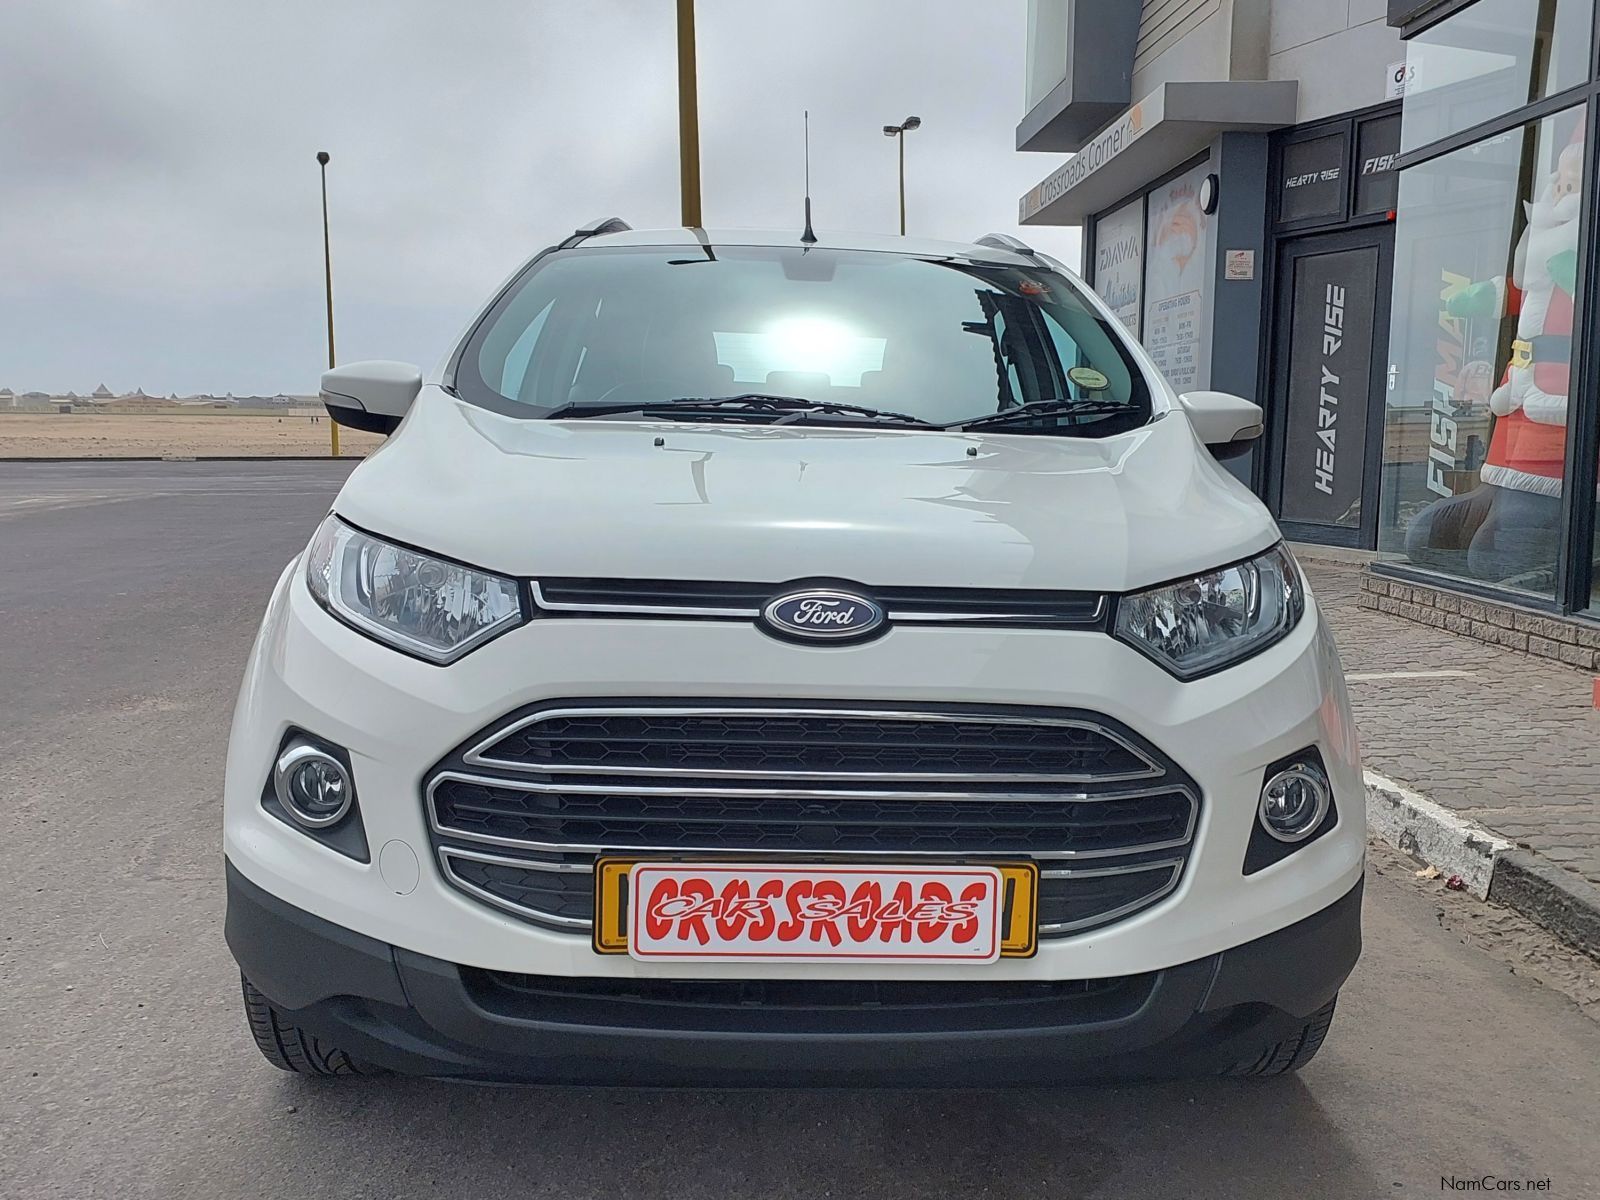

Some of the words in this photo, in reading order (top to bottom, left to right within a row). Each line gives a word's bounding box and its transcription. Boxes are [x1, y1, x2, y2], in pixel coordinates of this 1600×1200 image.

[1040, 155, 1086, 206] Crossroads
[1088, 122, 1126, 171] Corner
[1285, 172, 1319, 188] HEARTY
[1320, 168, 1340, 181] RISE
[1322, 283, 1345, 356] RISE
[1315, 364, 1340, 495] HEARTY
[793, 599, 856, 625] Ford
[645, 878, 987, 947] CROSSROADS
[652, 896, 771, 921] CAR
[798, 899, 979, 921] SALES
